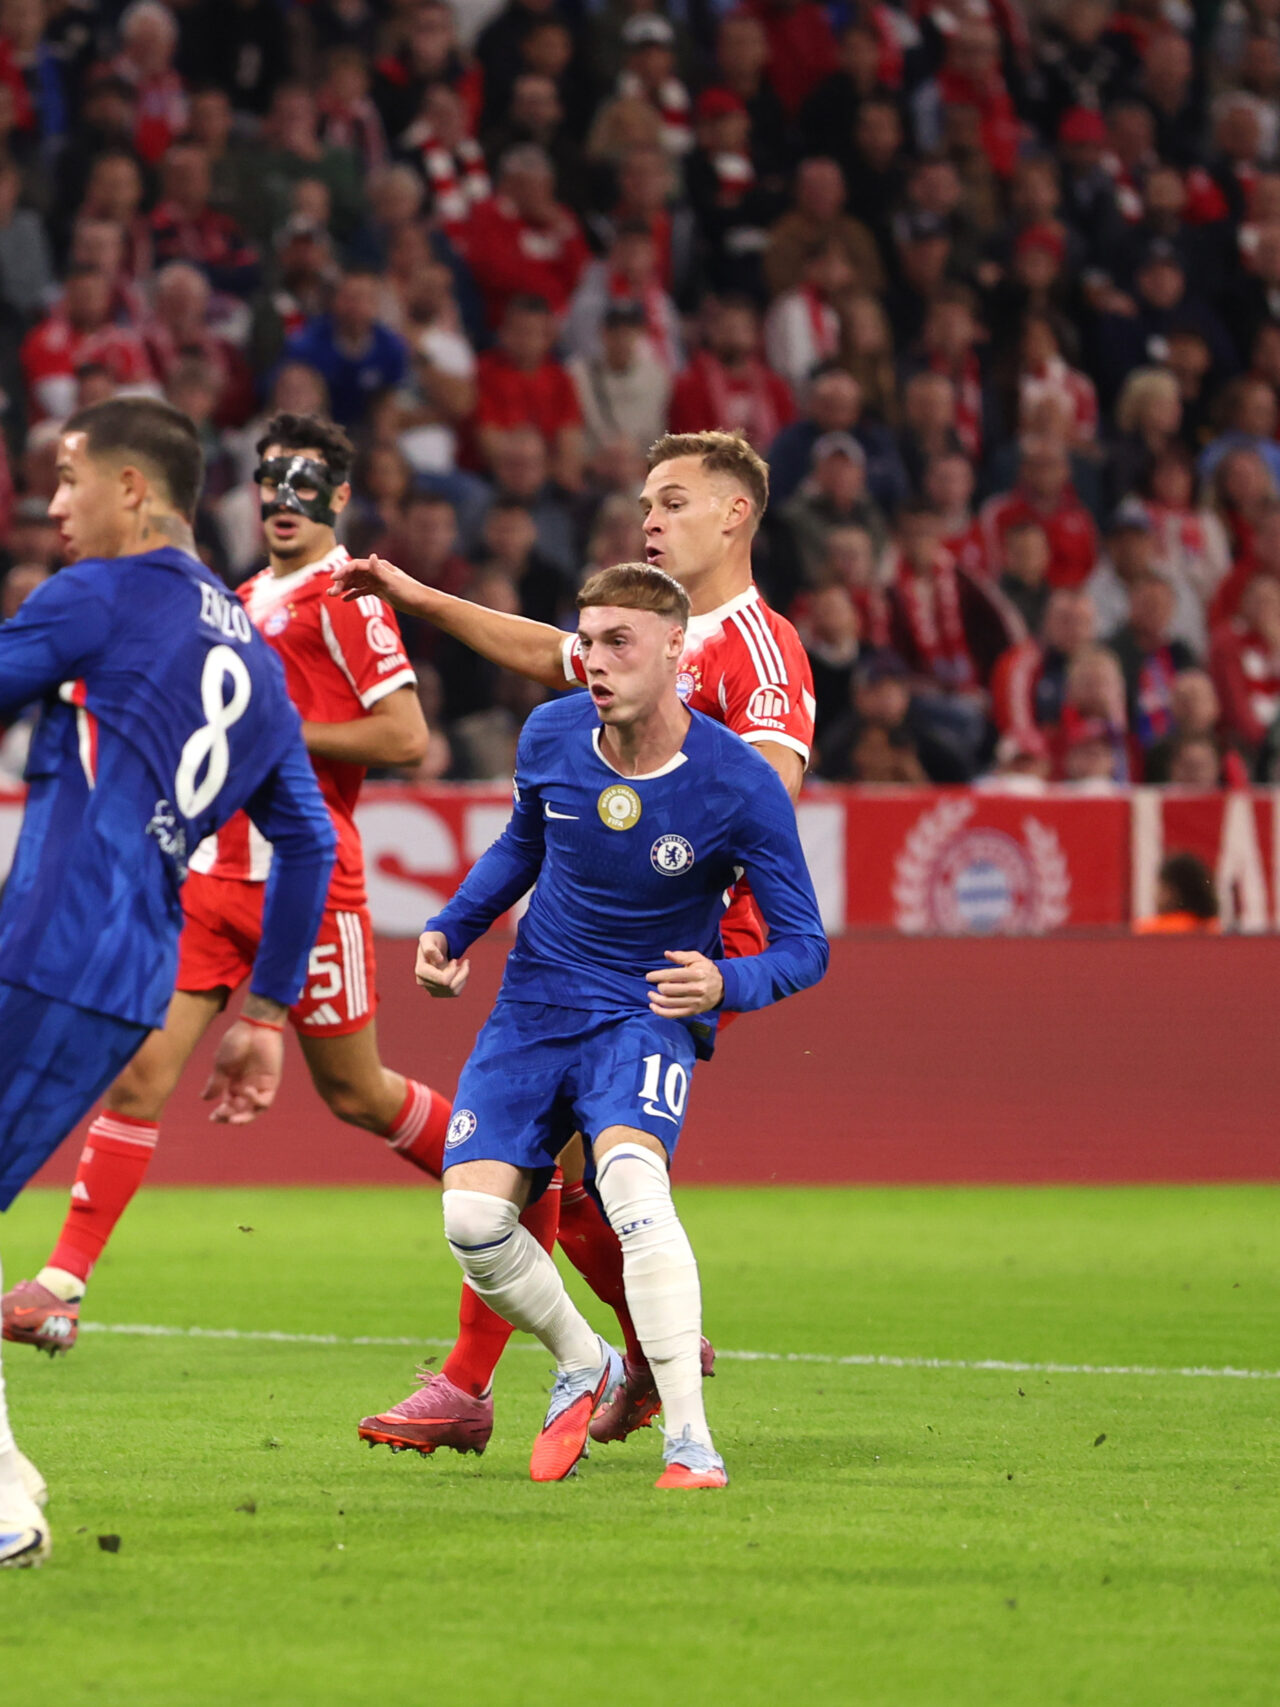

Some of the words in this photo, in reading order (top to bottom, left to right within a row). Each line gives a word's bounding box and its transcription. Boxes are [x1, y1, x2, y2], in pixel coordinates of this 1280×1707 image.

[200, 582, 252, 644] ENZO
[175, 644, 252, 819] 8
[601, 789, 617, 808] WORLD
[607, 816, 624, 828] FIFA
[659, 835, 688, 848] CHELSEA
[637, 1053, 688, 1116] 10
